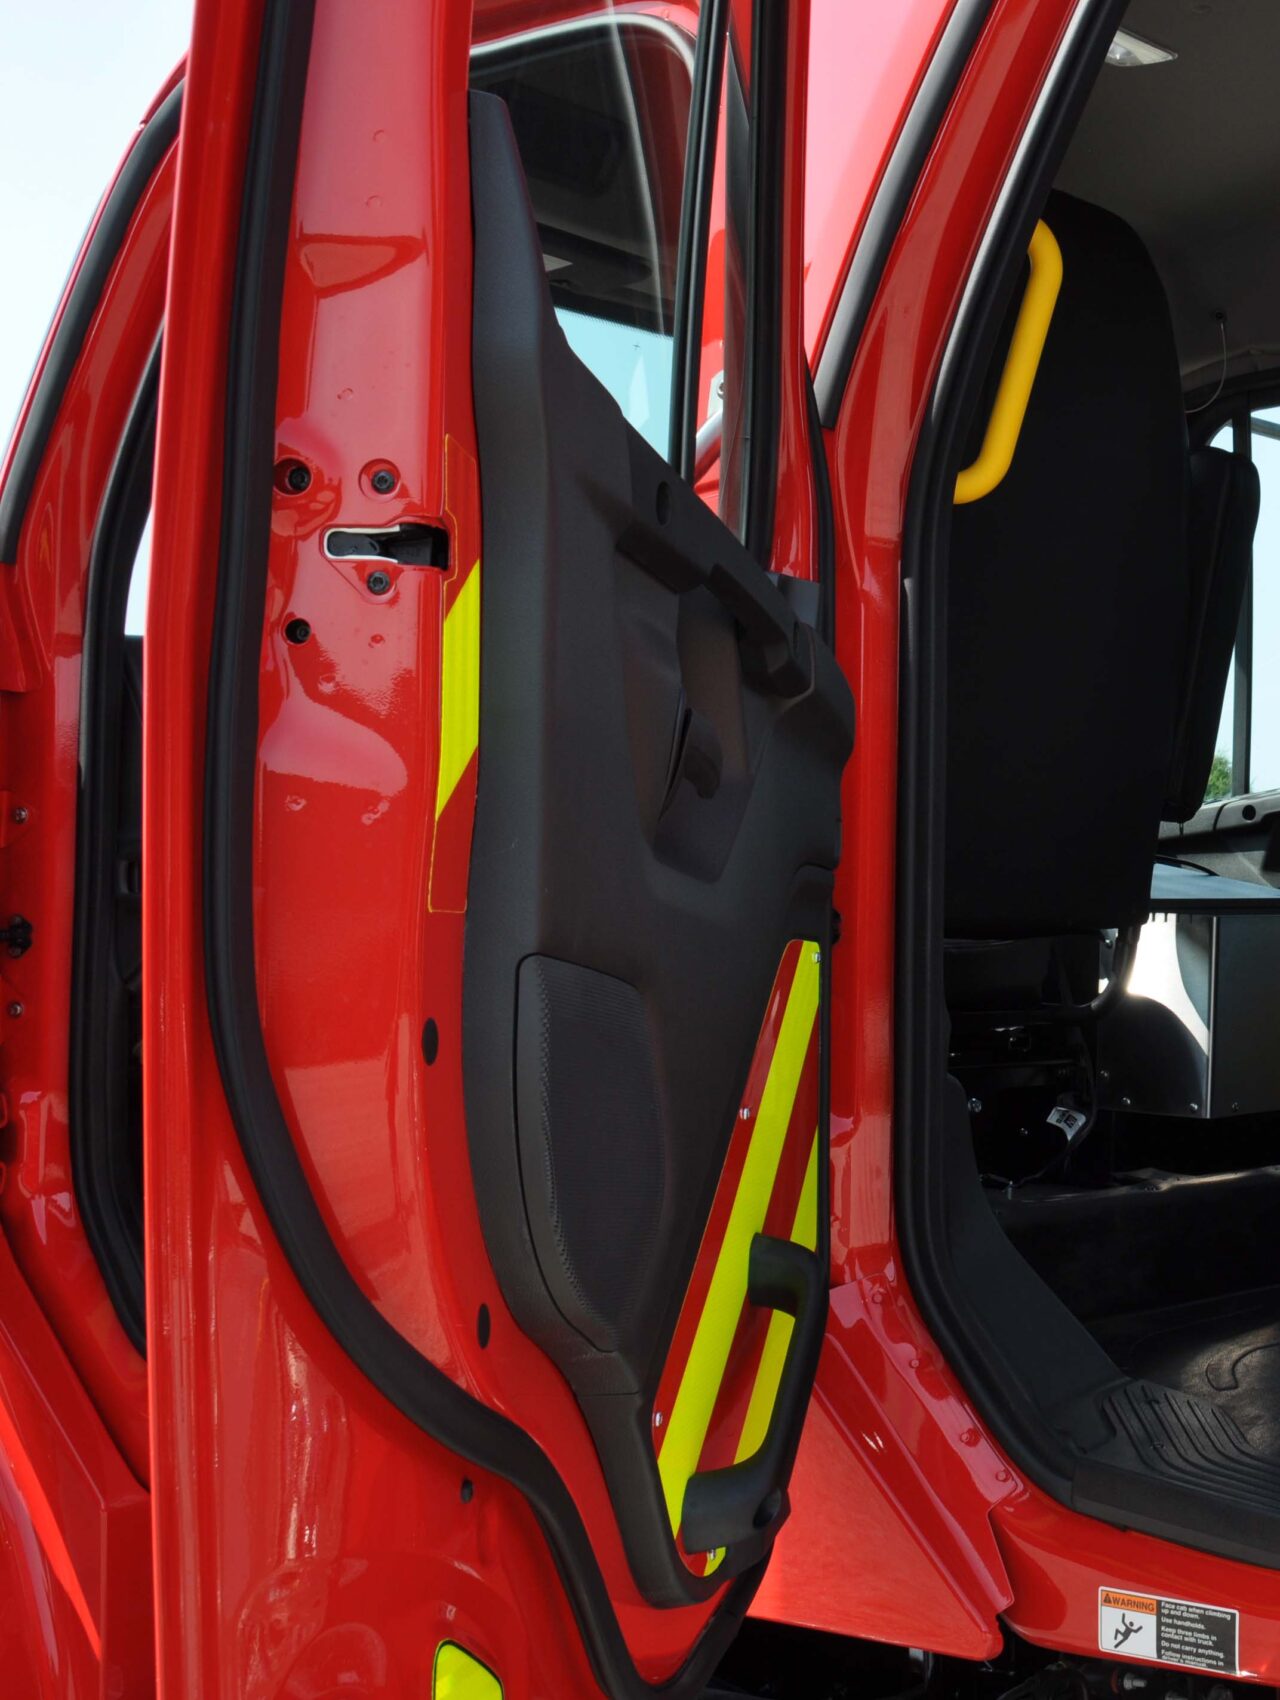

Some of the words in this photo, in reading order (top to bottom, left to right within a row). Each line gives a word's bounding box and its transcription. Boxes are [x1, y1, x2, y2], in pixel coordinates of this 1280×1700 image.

[1111, 1595, 1155, 1612] WARNING
[1161, 1601, 1175, 1609] Face
[1188, 1607, 1204, 1615] when
[1205, 1609, 1231, 1621] climbing
[1182, 1611, 1200, 1619] down.
[1161, 1616, 1172, 1624] Use
[1161, 1625, 1176, 1634] Keep
[1177, 1628, 1192, 1636] three
[1193, 1631, 1210, 1640] limbs
[1161, 1632, 1182, 1640] contact
[1181, 1645, 1196, 1653] carry
[1161, 1649, 1181, 1658] Follow
[1181, 1654, 1217, 1665] instructions
